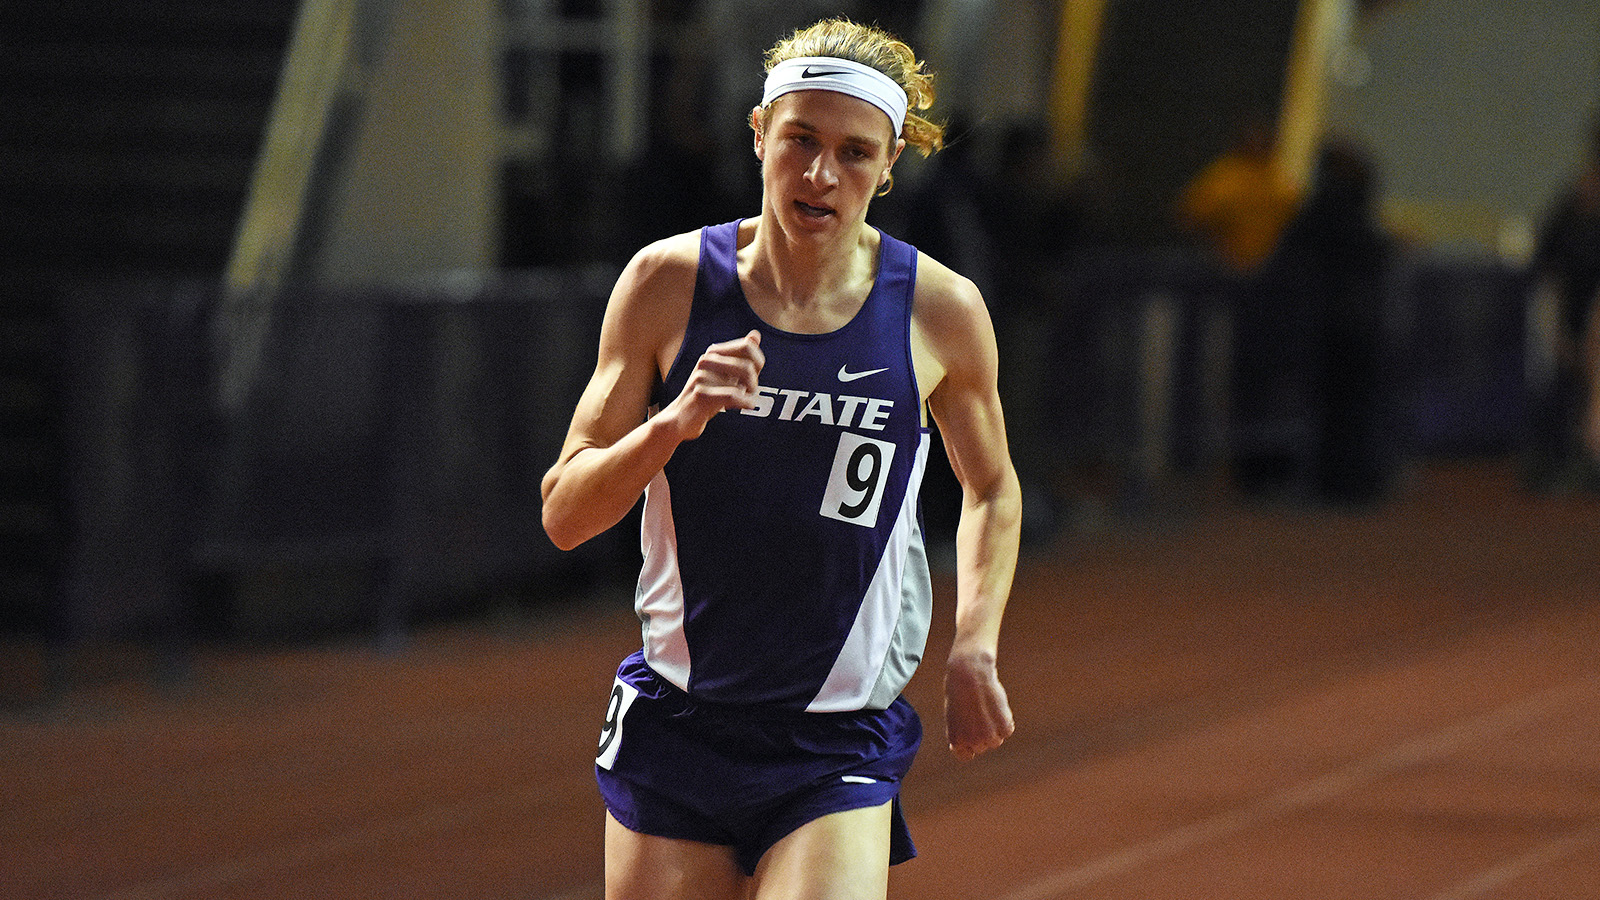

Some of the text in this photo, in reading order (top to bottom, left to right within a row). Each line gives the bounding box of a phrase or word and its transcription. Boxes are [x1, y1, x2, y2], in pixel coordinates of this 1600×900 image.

[719, 385, 895, 431] STATE
[837, 442, 882, 519] 9
[597, 684, 624, 758] 9
